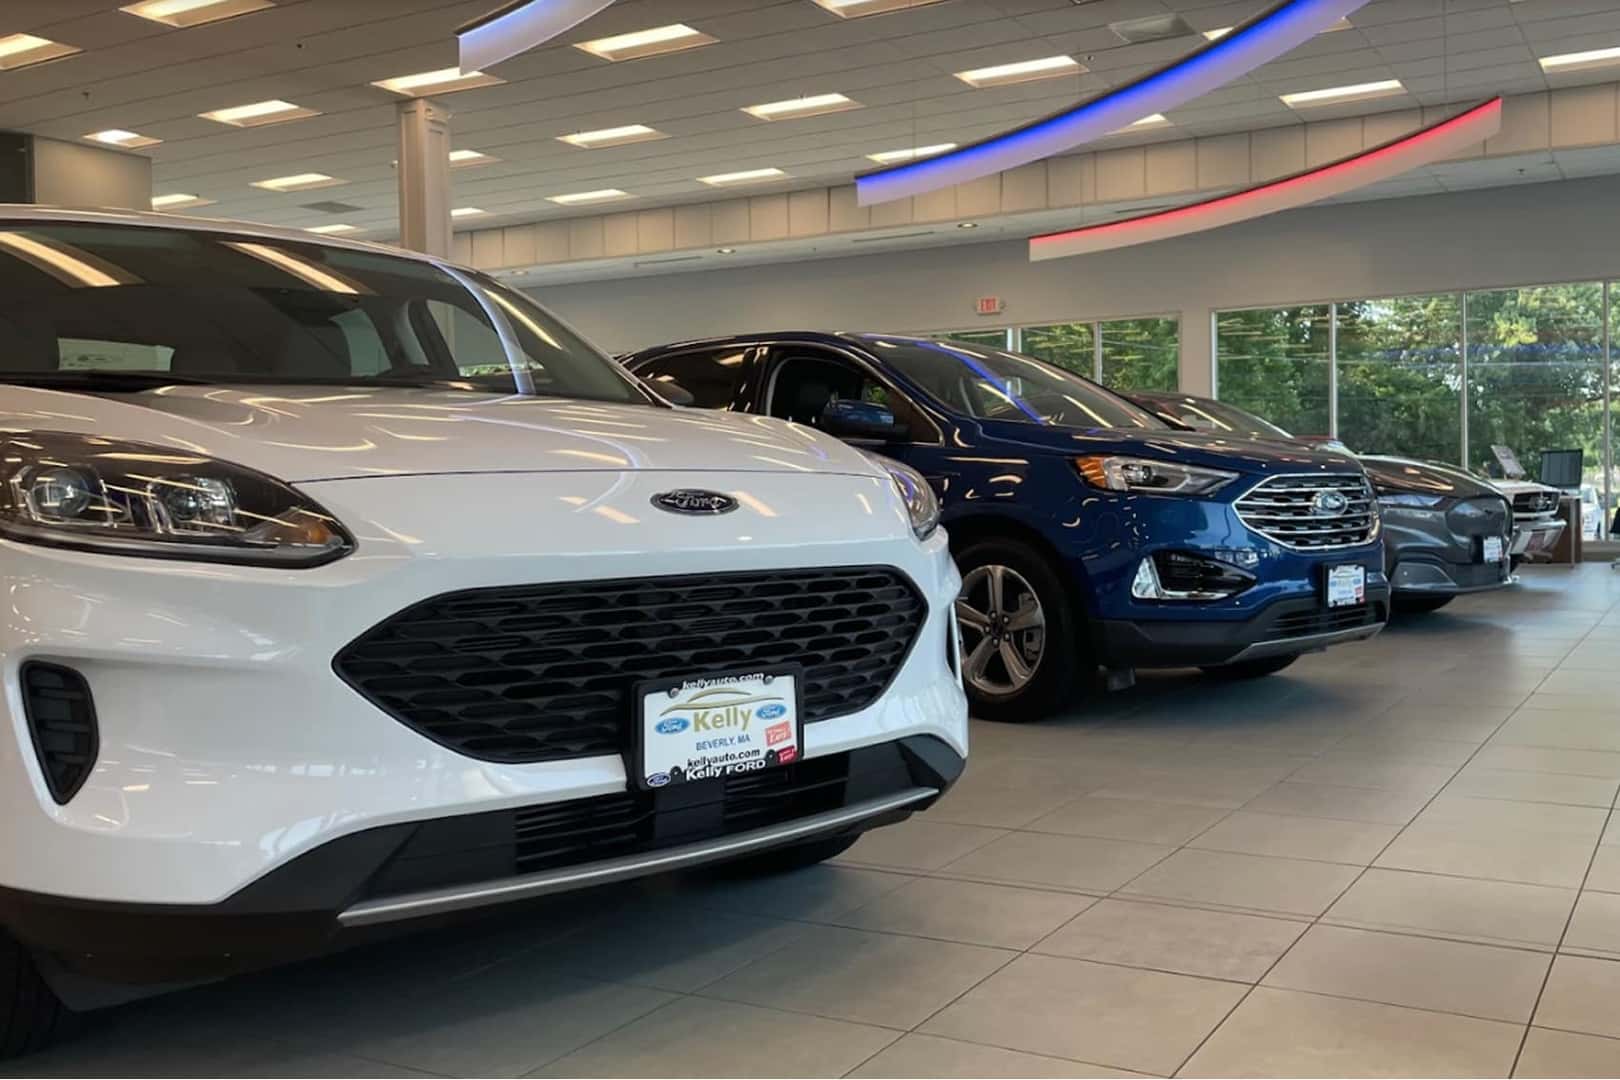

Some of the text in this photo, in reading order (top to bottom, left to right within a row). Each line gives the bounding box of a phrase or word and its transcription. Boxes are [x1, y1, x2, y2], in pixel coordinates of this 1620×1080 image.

[656, 489, 733, 512] Ford
[683, 672, 765, 690] kellyauto.com
[693, 706, 752, 733] Kelly
[737, 734, 751, 744] MA
[687, 748, 761, 769] kellyauto.com
[685, 759, 766, 781] Kelly FORD
